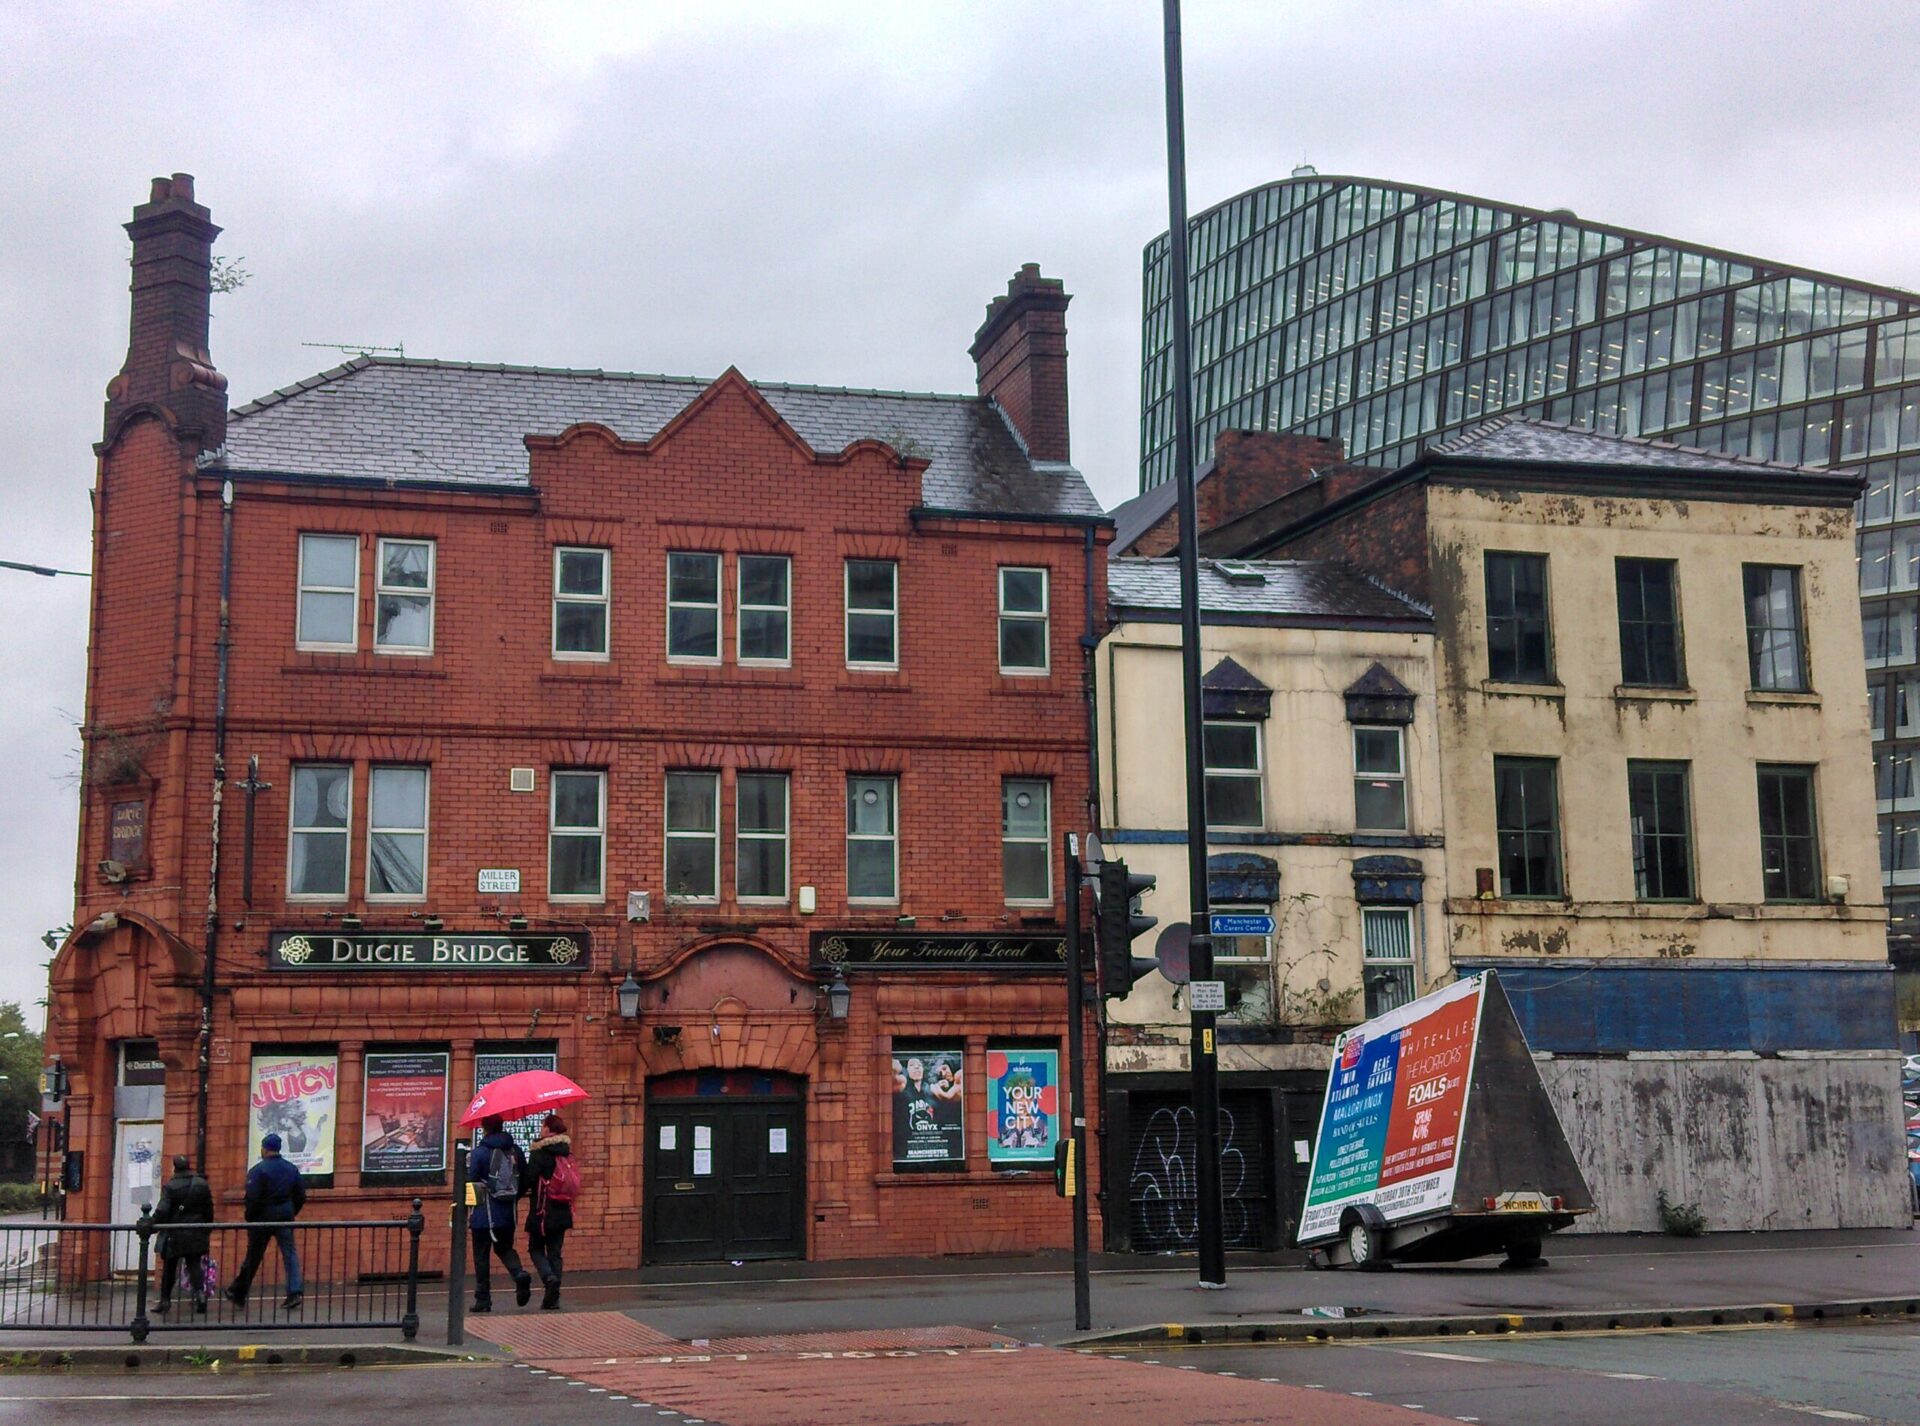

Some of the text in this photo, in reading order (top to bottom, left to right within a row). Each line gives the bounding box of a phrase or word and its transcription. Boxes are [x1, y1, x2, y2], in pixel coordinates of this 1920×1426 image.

[480, 881, 518, 890] STREET
[481, 871, 517, 880] MILLER
[331, 938, 531, 963] DUCIE BRIDGE
[869, 939, 1034, 962] Your Friendly Local
[1401, 1017, 1476, 1058] WHITE LIES
[1373, 1055, 1391, 1073] DEAF
[1405, 1046, 1462, 1081] THE HORRORS
[252, 1062, 336, 1109] JUICY
[1367, 1070, 1392, 1090] HAVANA
[1002, 1086, 1043, 1100] YOUR
[1331, 1083, 1360, 1103] ATLANTIC
[1407, 1076, 1448, 1107] FOALS
[1005, 1101, 1039, 1115] NEW
[1333, 1092, 1383, 1121] MALLORY KNOX
[1005, 1116, 1041, 1130] CITY
[1332, 1124, 1349, 1138] BAND
[1356, 1114, 1378, 1129] SKULLS
[1368, 1160, 1378, 1170] CITY
[1376, 1190, 1398, 1204] SATURDAY
[1397, 1185, 1411, 1199] 30TH
[1411, 1177, 1441, 1196] SEPTEMBER
[1307, 1207, 1321, 1221] FRIDAY
